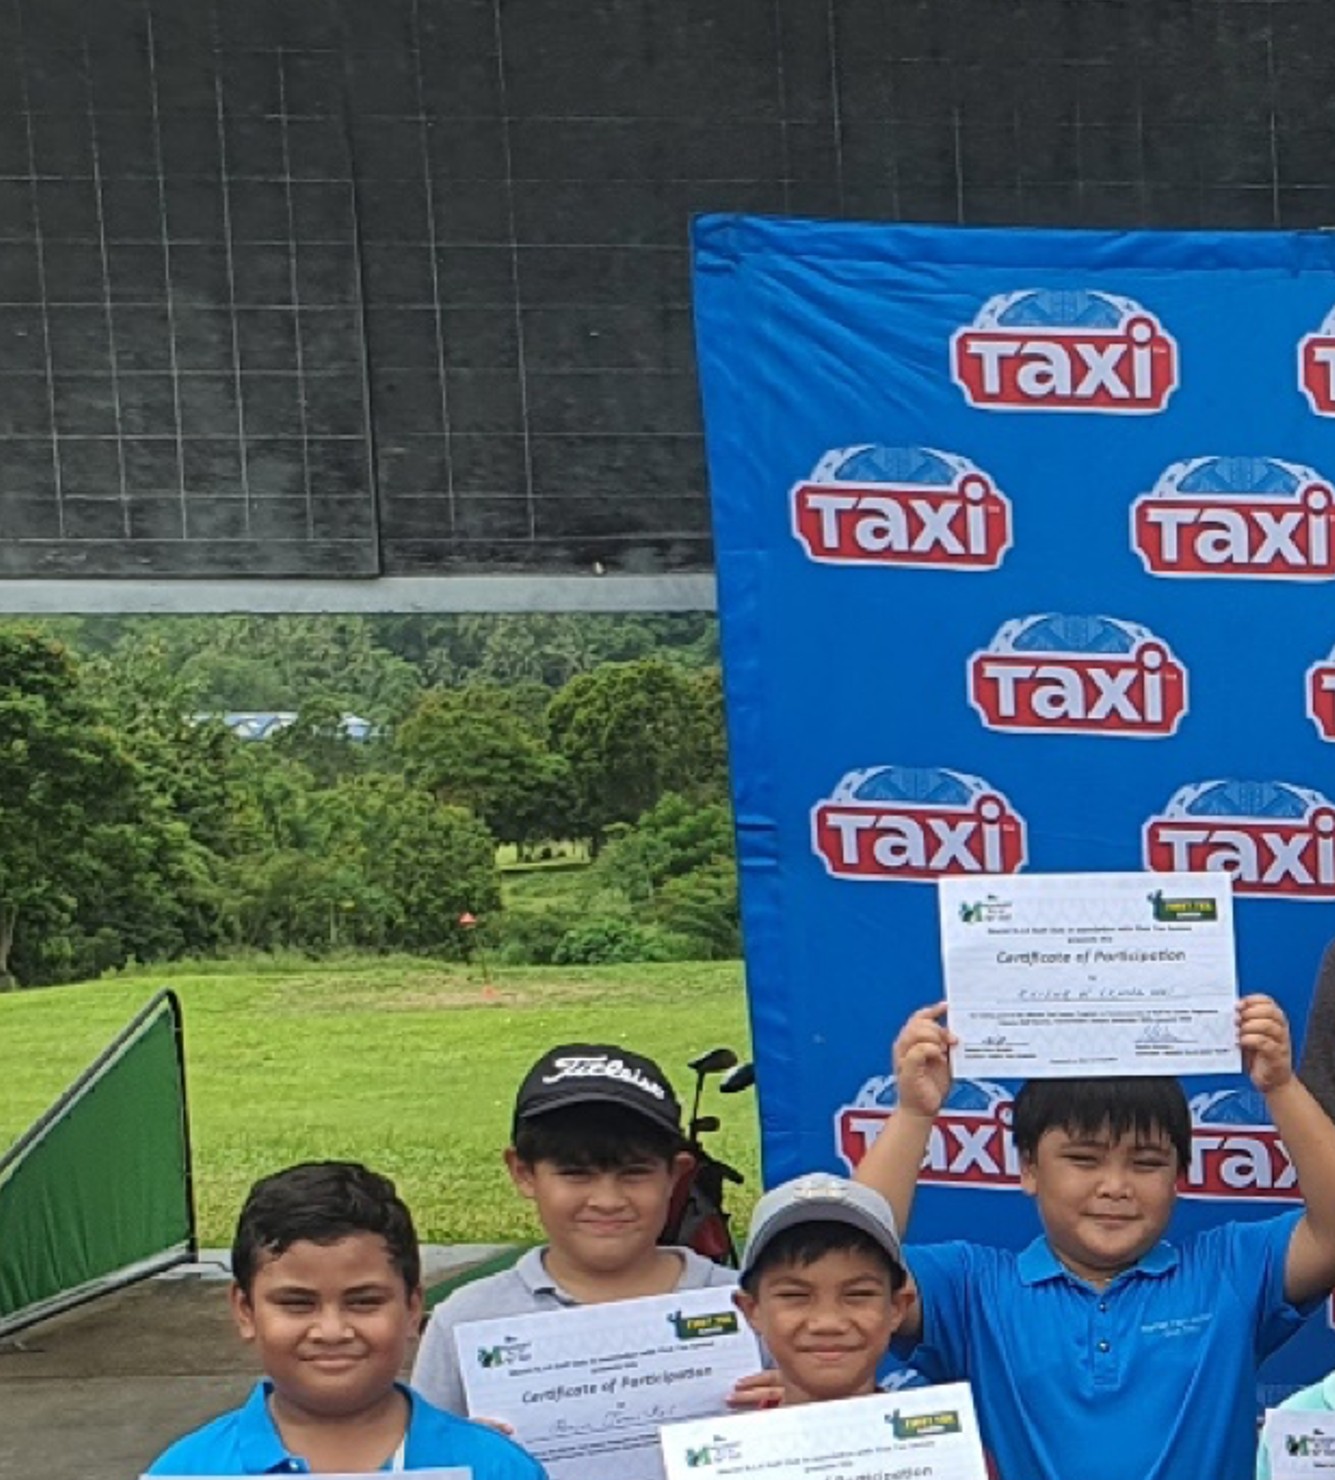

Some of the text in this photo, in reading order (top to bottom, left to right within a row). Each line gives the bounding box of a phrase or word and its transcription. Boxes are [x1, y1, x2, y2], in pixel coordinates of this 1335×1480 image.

[966, 320, 1155, 400] Taxi
[807, 480, 988, 556] Taxi
[1147, 489, 1329, 567] Taxi
[984, 647, 1165, 722] Taxi
[827, 800, 1003, 874] Taxi
[1160, 813, 1335, 886] Taxi
